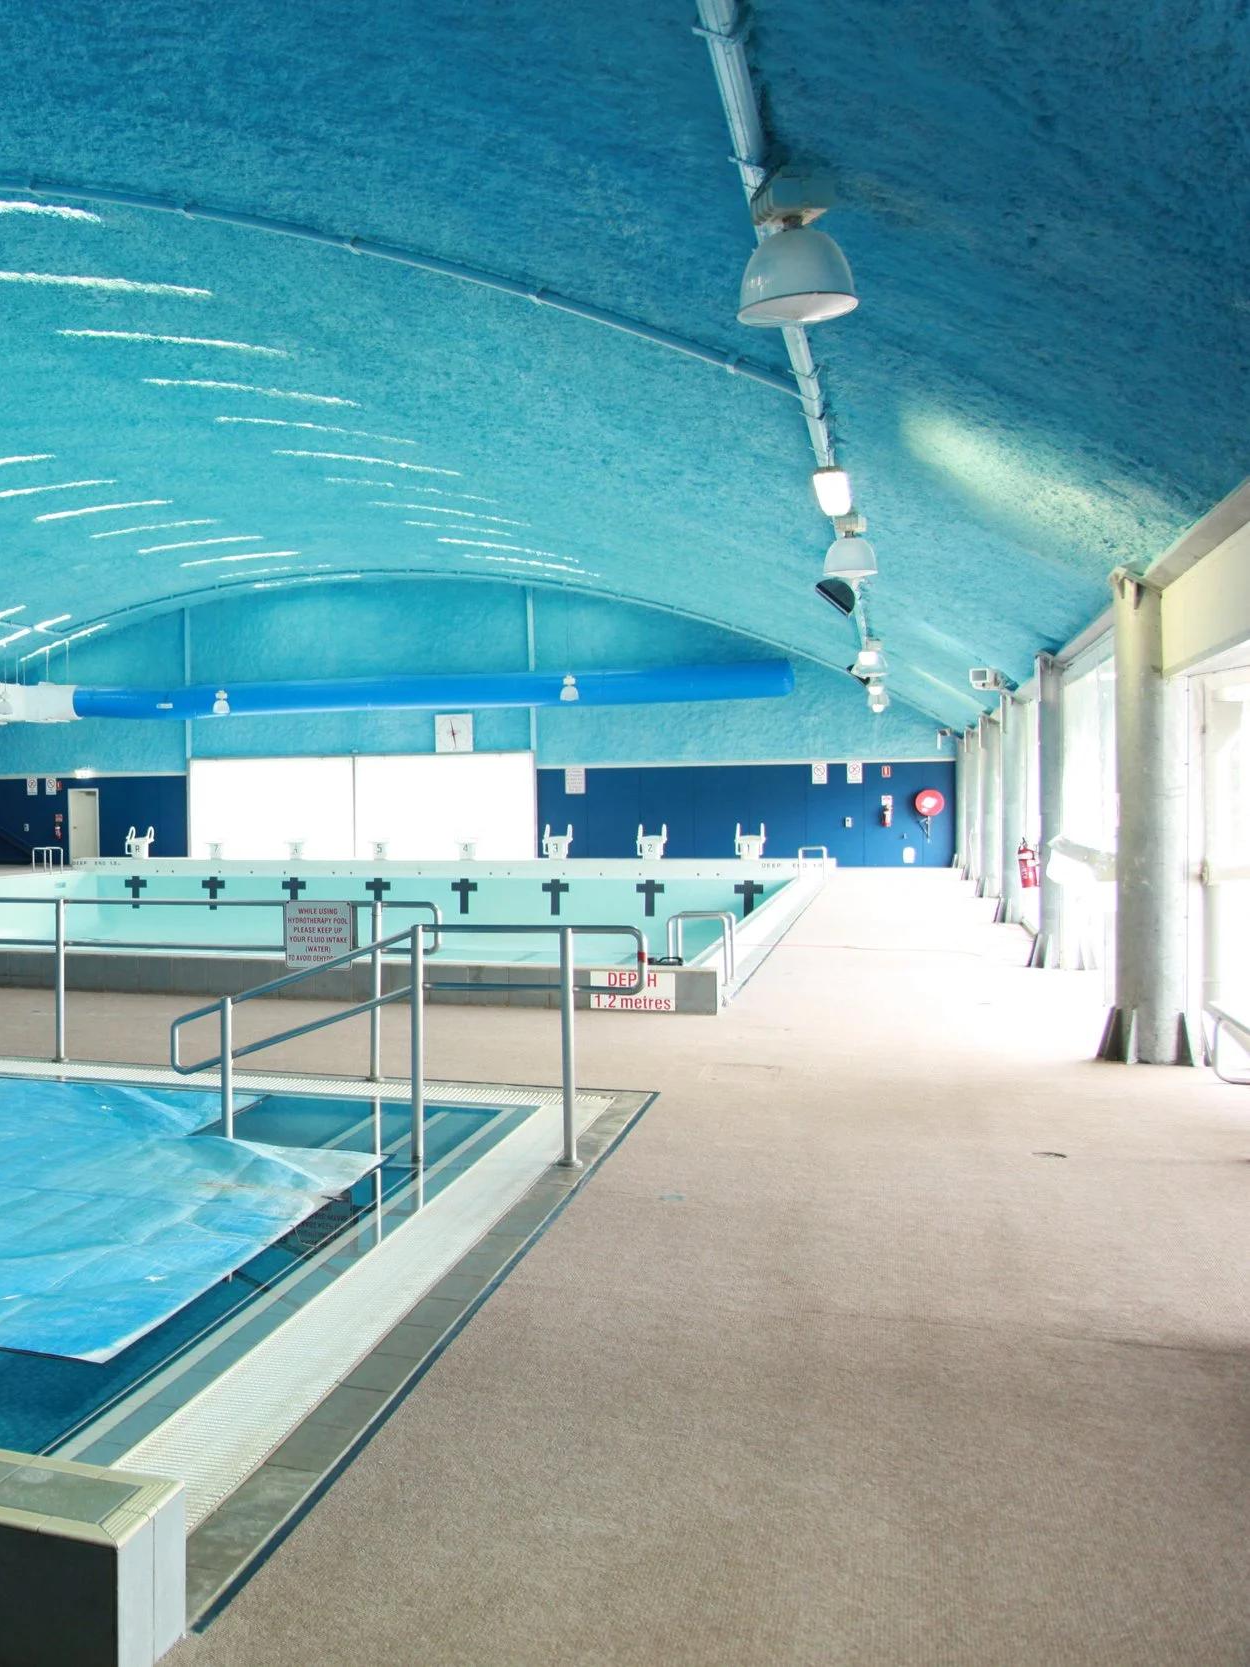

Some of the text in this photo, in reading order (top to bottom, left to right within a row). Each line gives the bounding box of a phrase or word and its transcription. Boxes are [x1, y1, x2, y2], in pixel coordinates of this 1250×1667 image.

[333, 917, 348, 925] POOL
[607, 972, 657, 988] DEPH
[594, 993, 672, 1010] 1.2 metres
